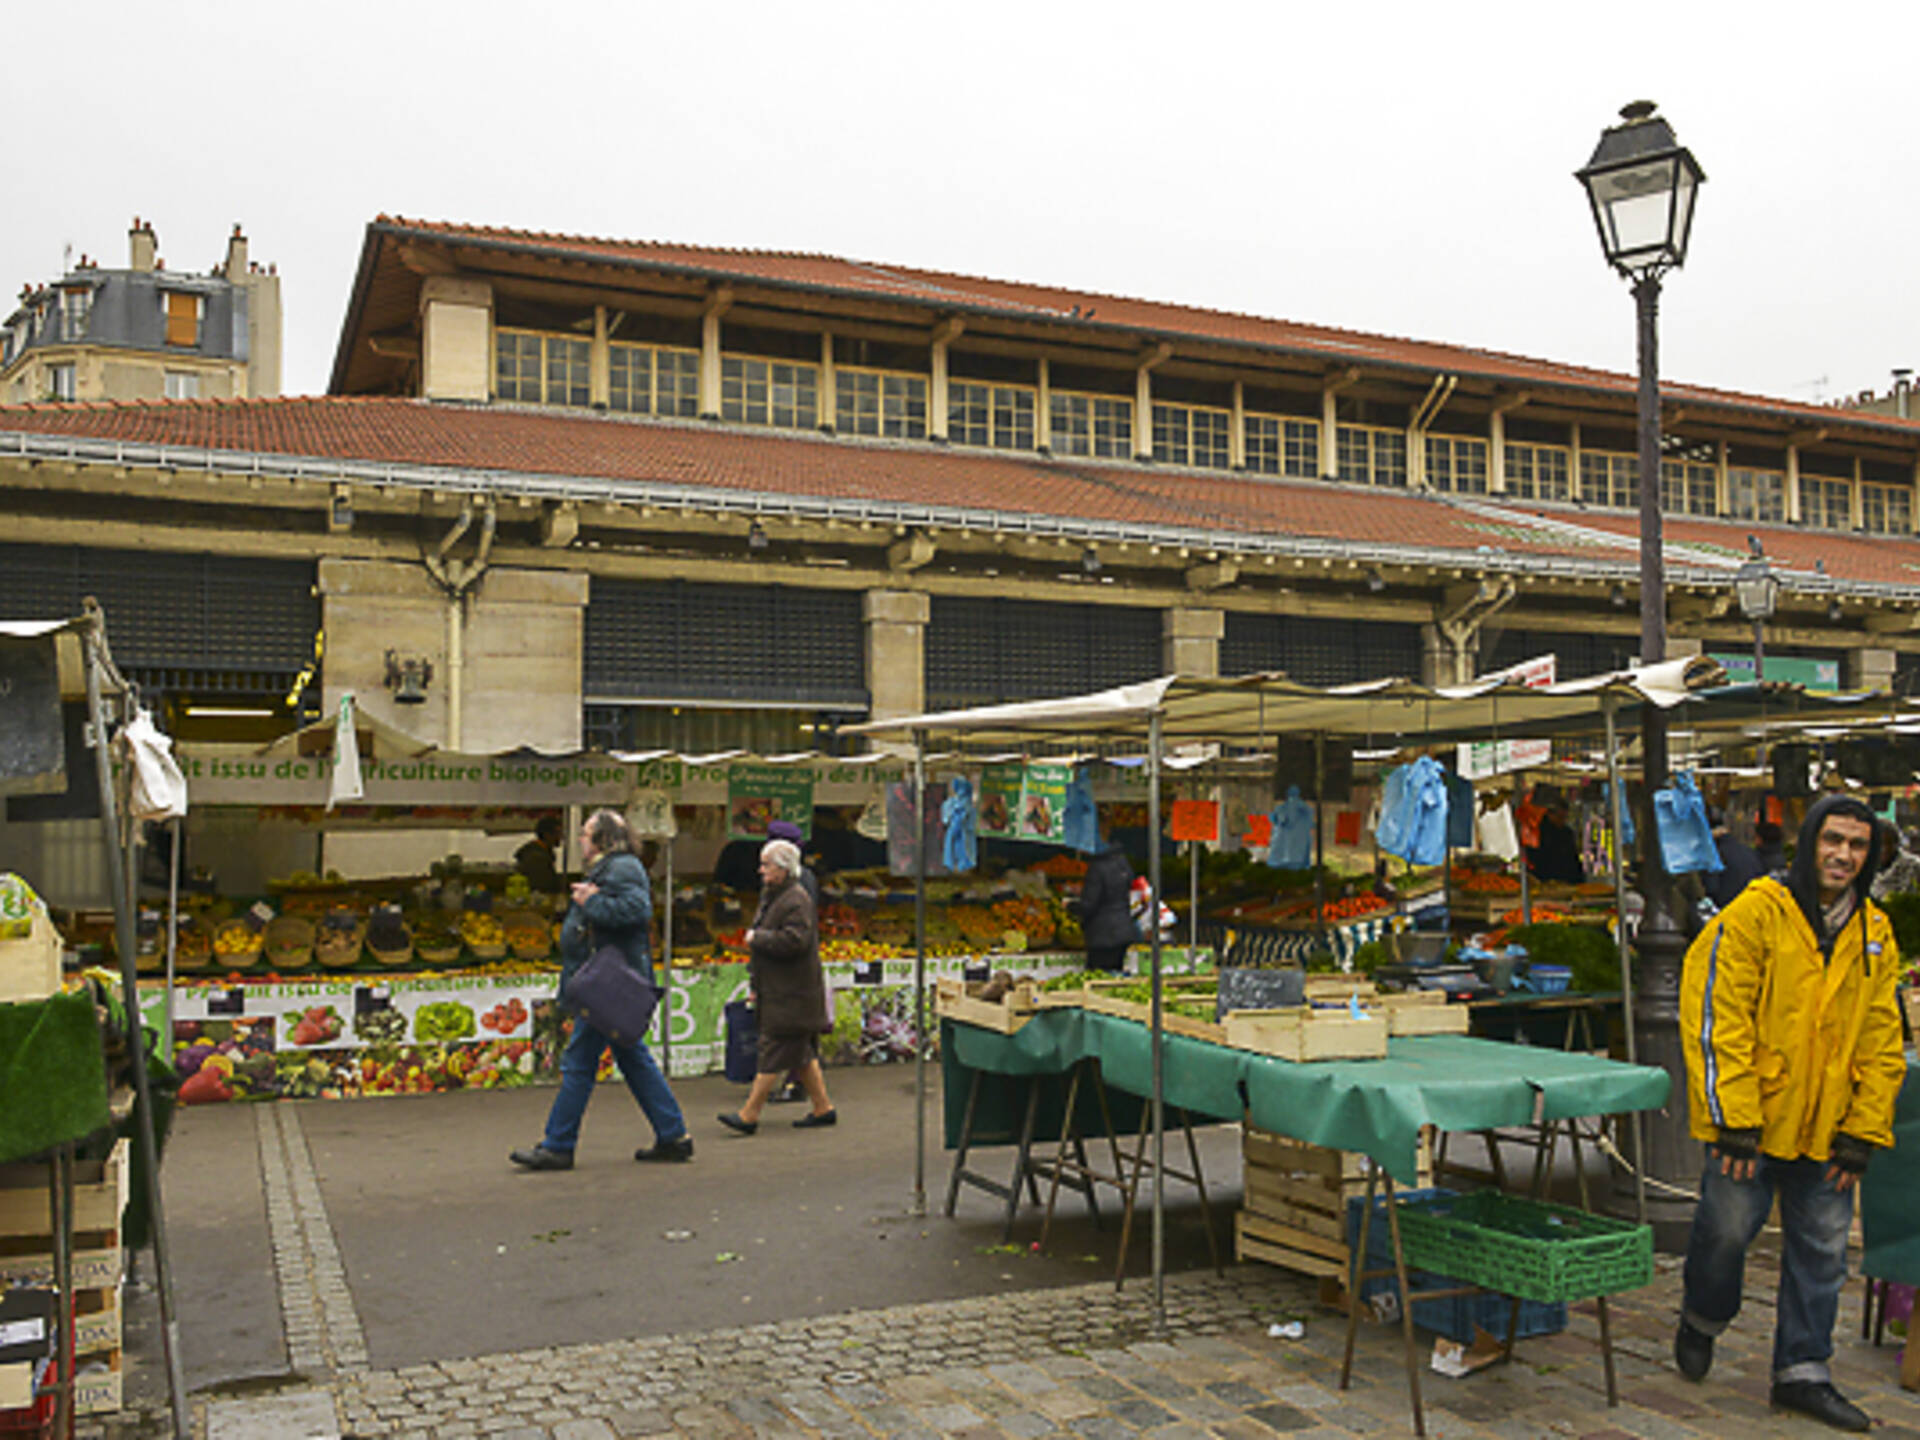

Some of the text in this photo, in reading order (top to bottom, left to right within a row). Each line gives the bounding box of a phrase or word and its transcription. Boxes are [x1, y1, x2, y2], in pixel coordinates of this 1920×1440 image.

[210, 757, 266, 778] issu
[274, 759, 309, 779] de
[488, 762, 625, 787] biologique
